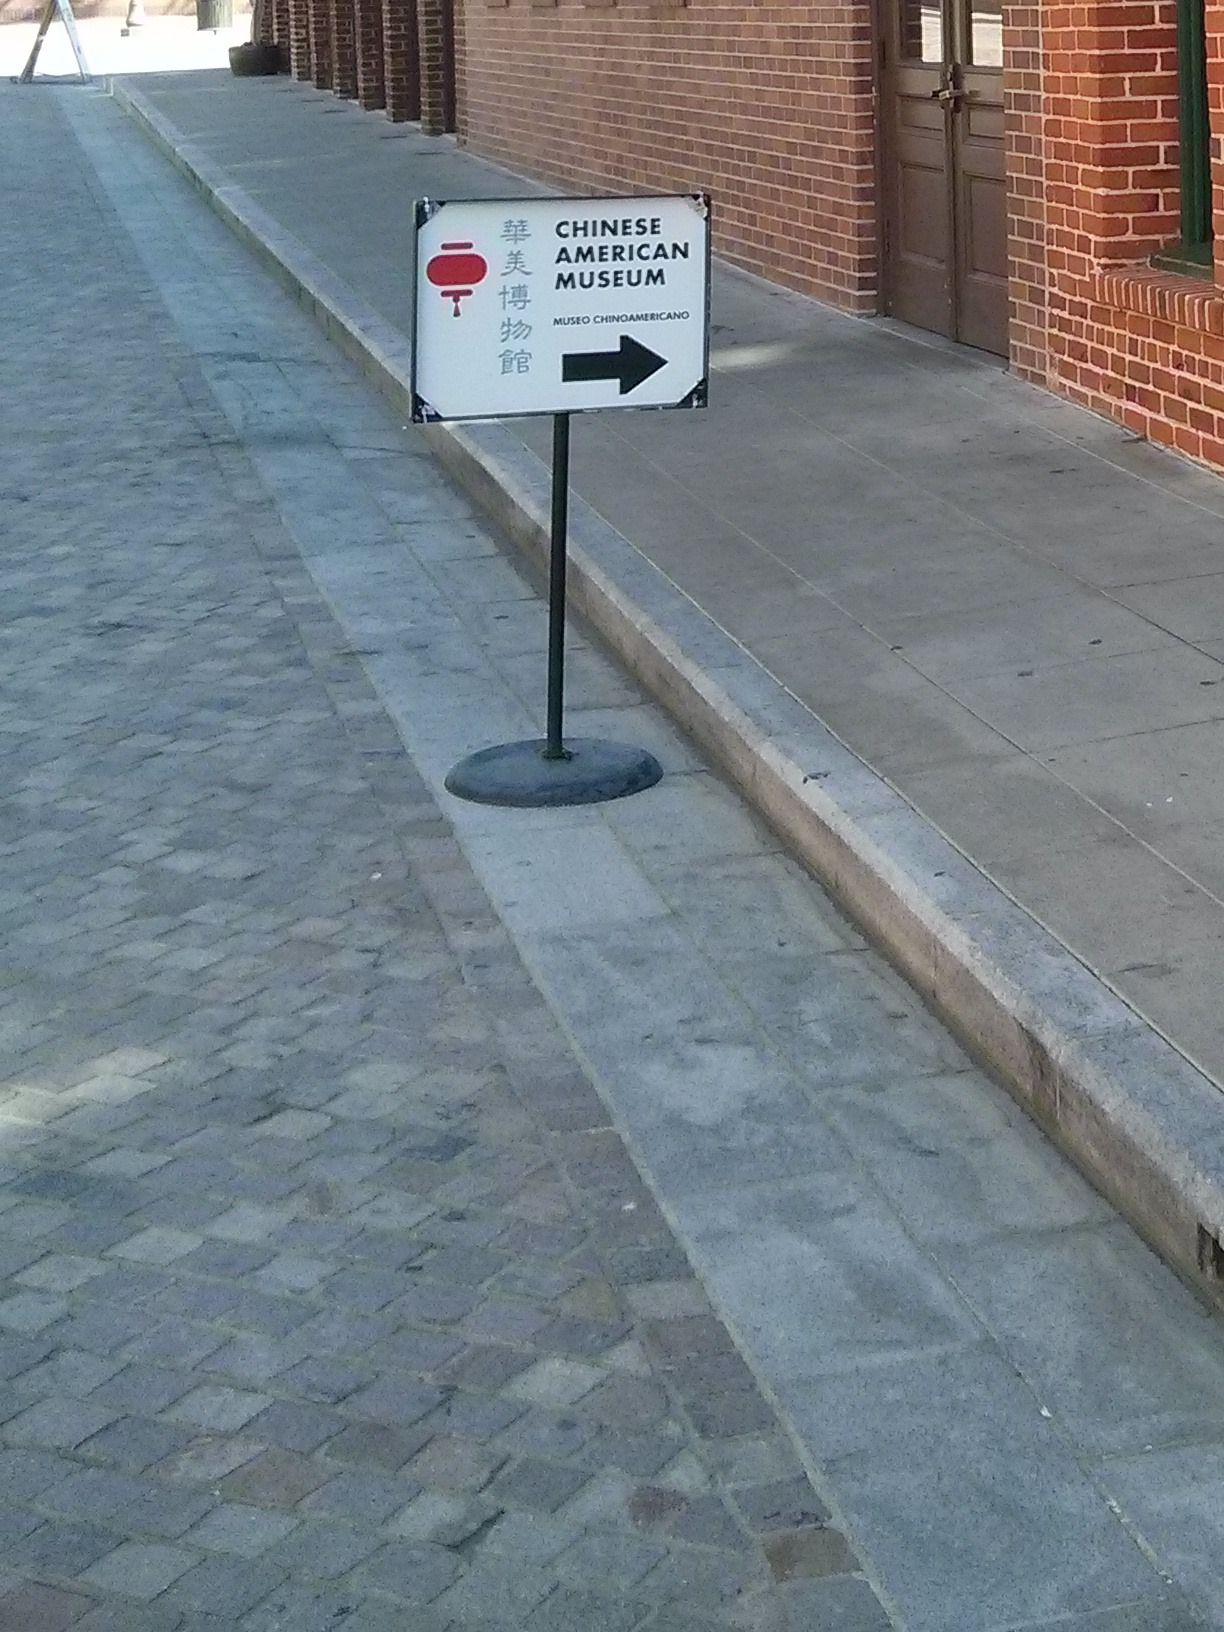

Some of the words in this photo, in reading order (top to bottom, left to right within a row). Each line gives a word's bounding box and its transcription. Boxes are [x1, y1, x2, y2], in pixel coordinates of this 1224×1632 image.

[554, 217, 662, 239] CHINESE
[554, 241, 690, 265] AMERICAN
[554, 268, 666, 291] MUSEUM
[498, 218, 534, 376] 華美博物館
[552, 316, 591, 327] MUSEO
[592, 310, 691, 325] CHINOAMERICANO
